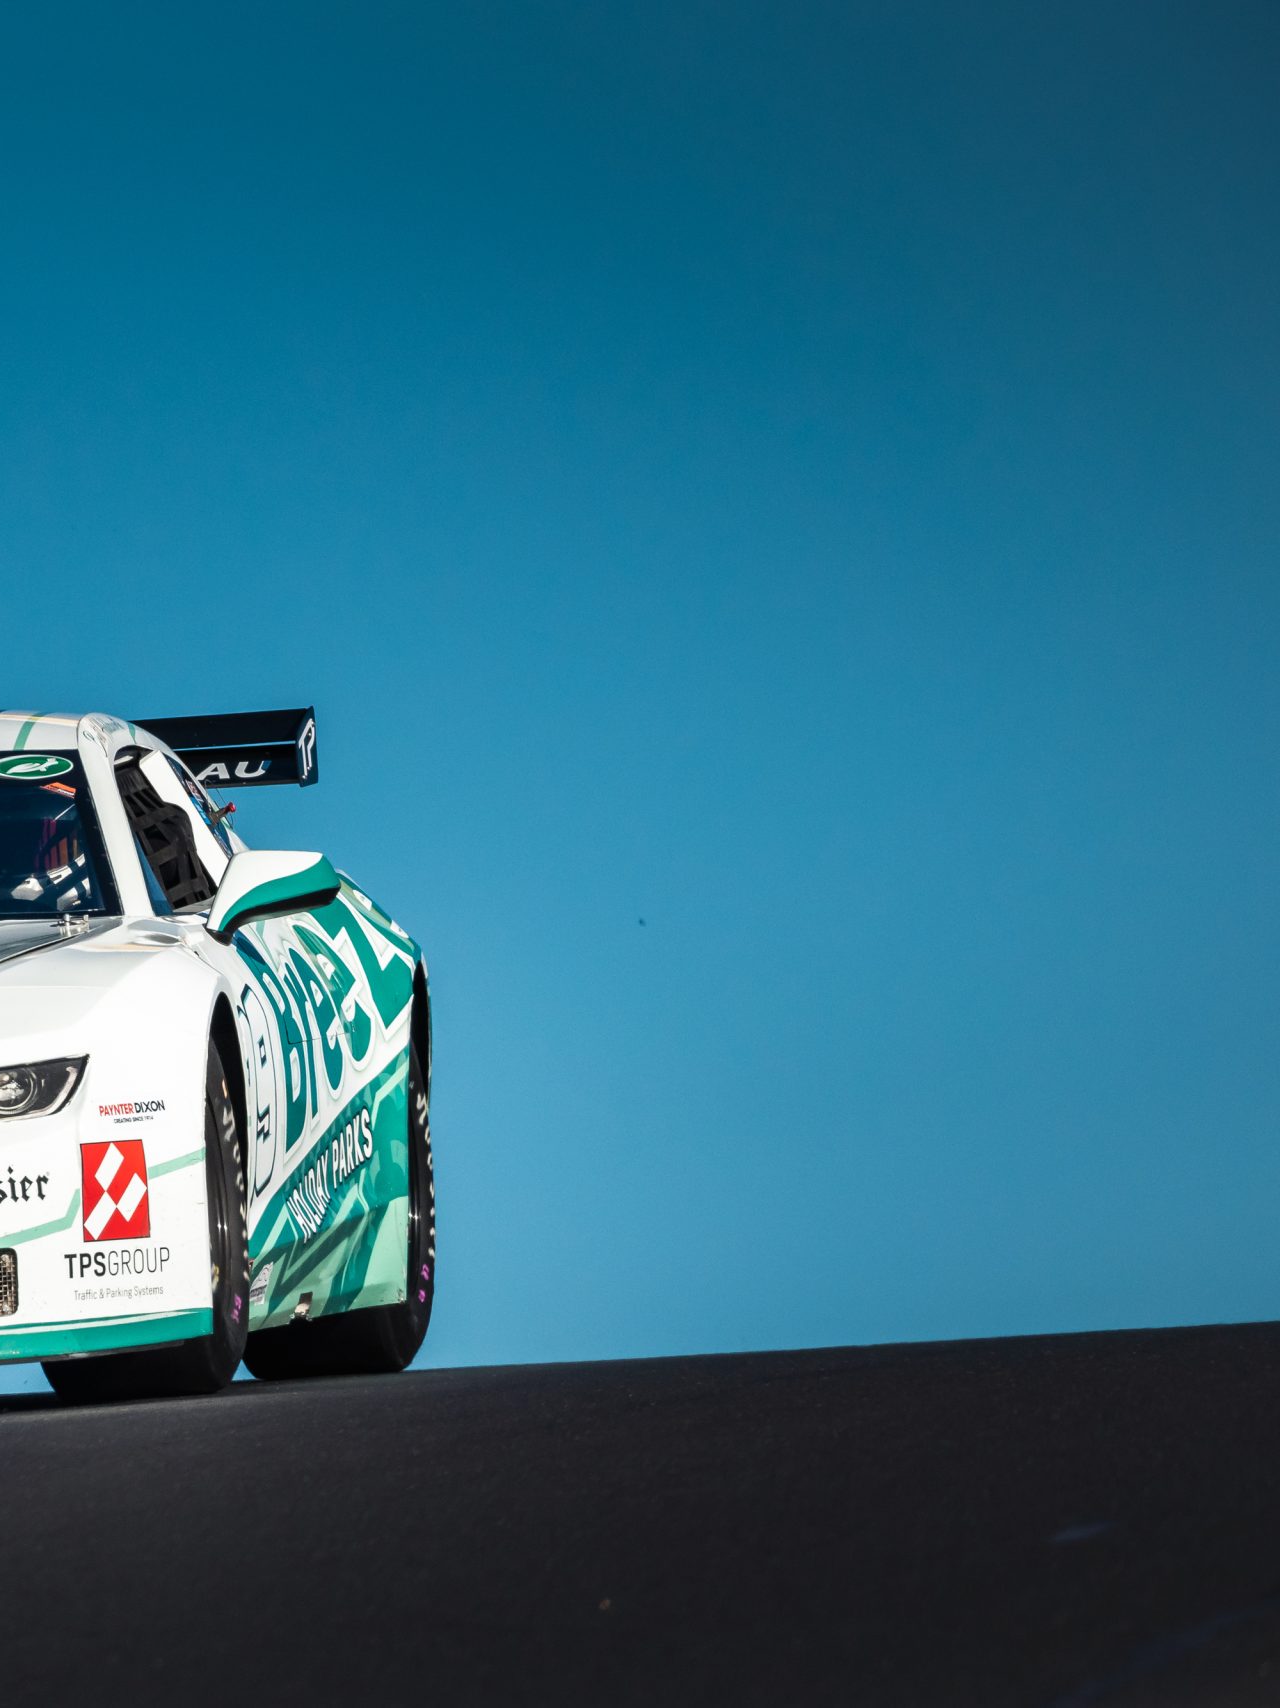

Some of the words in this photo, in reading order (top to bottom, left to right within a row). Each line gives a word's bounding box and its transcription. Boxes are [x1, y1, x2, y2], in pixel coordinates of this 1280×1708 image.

[287, 1150, 331, 1244] HOLIDAY
[332, 1108, 373, 1189] PARKS
[64, 1246, 170, 1279] TPSGROUP
[74, 1289, 97, 1301] Traffic
[99, 1288, 105, 1299] &
[106, 1287, 133, 1300] Parking
[133, 1285, 164, 1297] Systems
